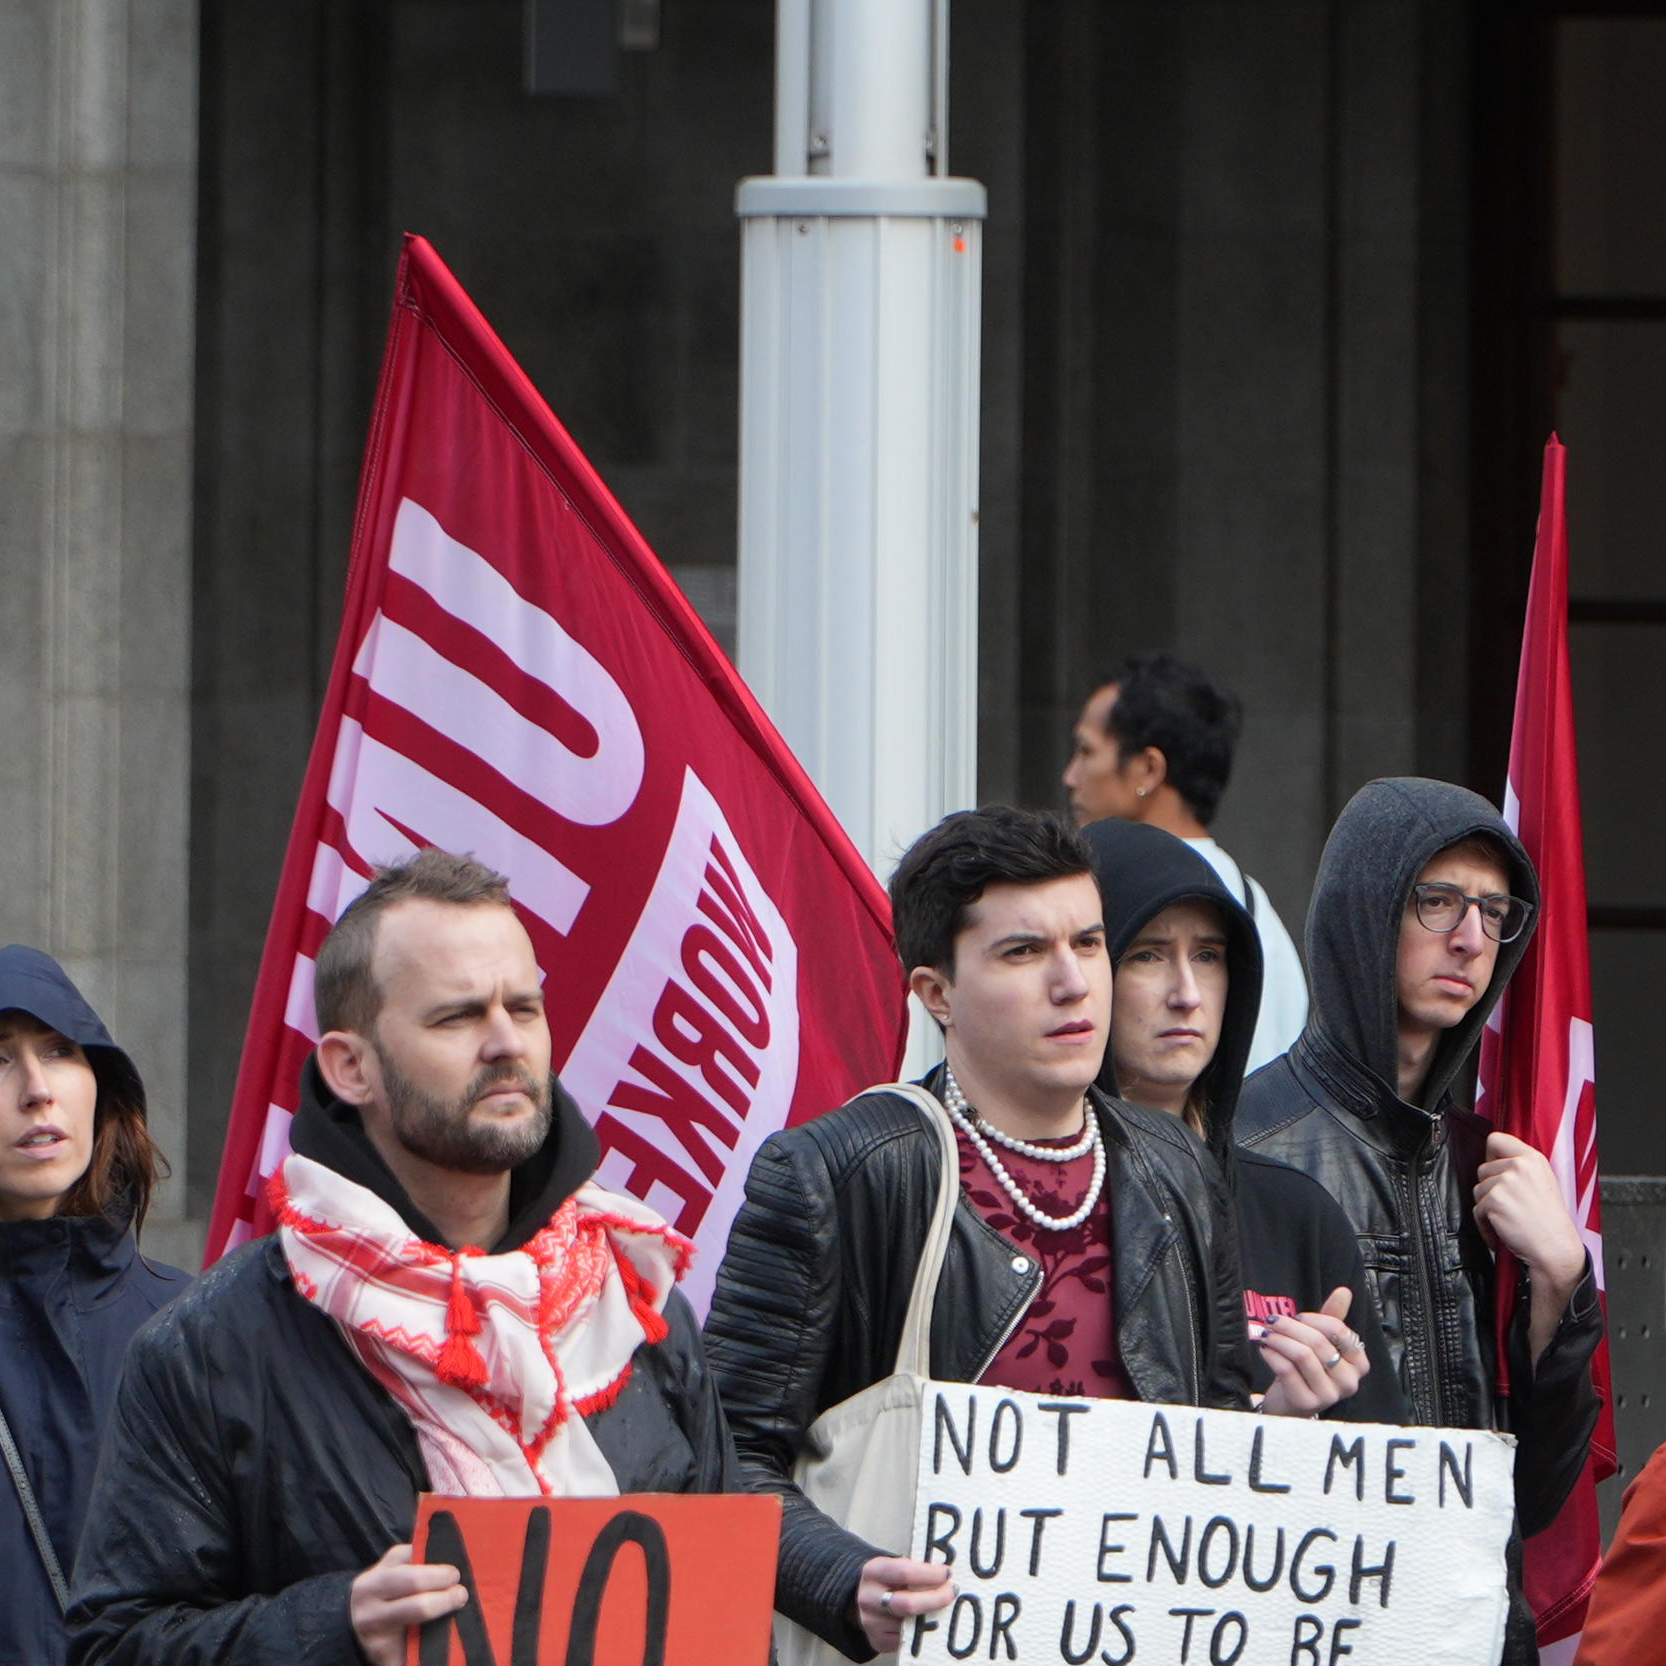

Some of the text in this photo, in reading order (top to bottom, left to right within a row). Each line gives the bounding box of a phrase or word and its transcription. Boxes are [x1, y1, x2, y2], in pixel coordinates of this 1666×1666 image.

[932, 1392, 1474, 1509] NOT ALL MEN
[922, 1502, 1397, 1608] BUT ENOUGH
